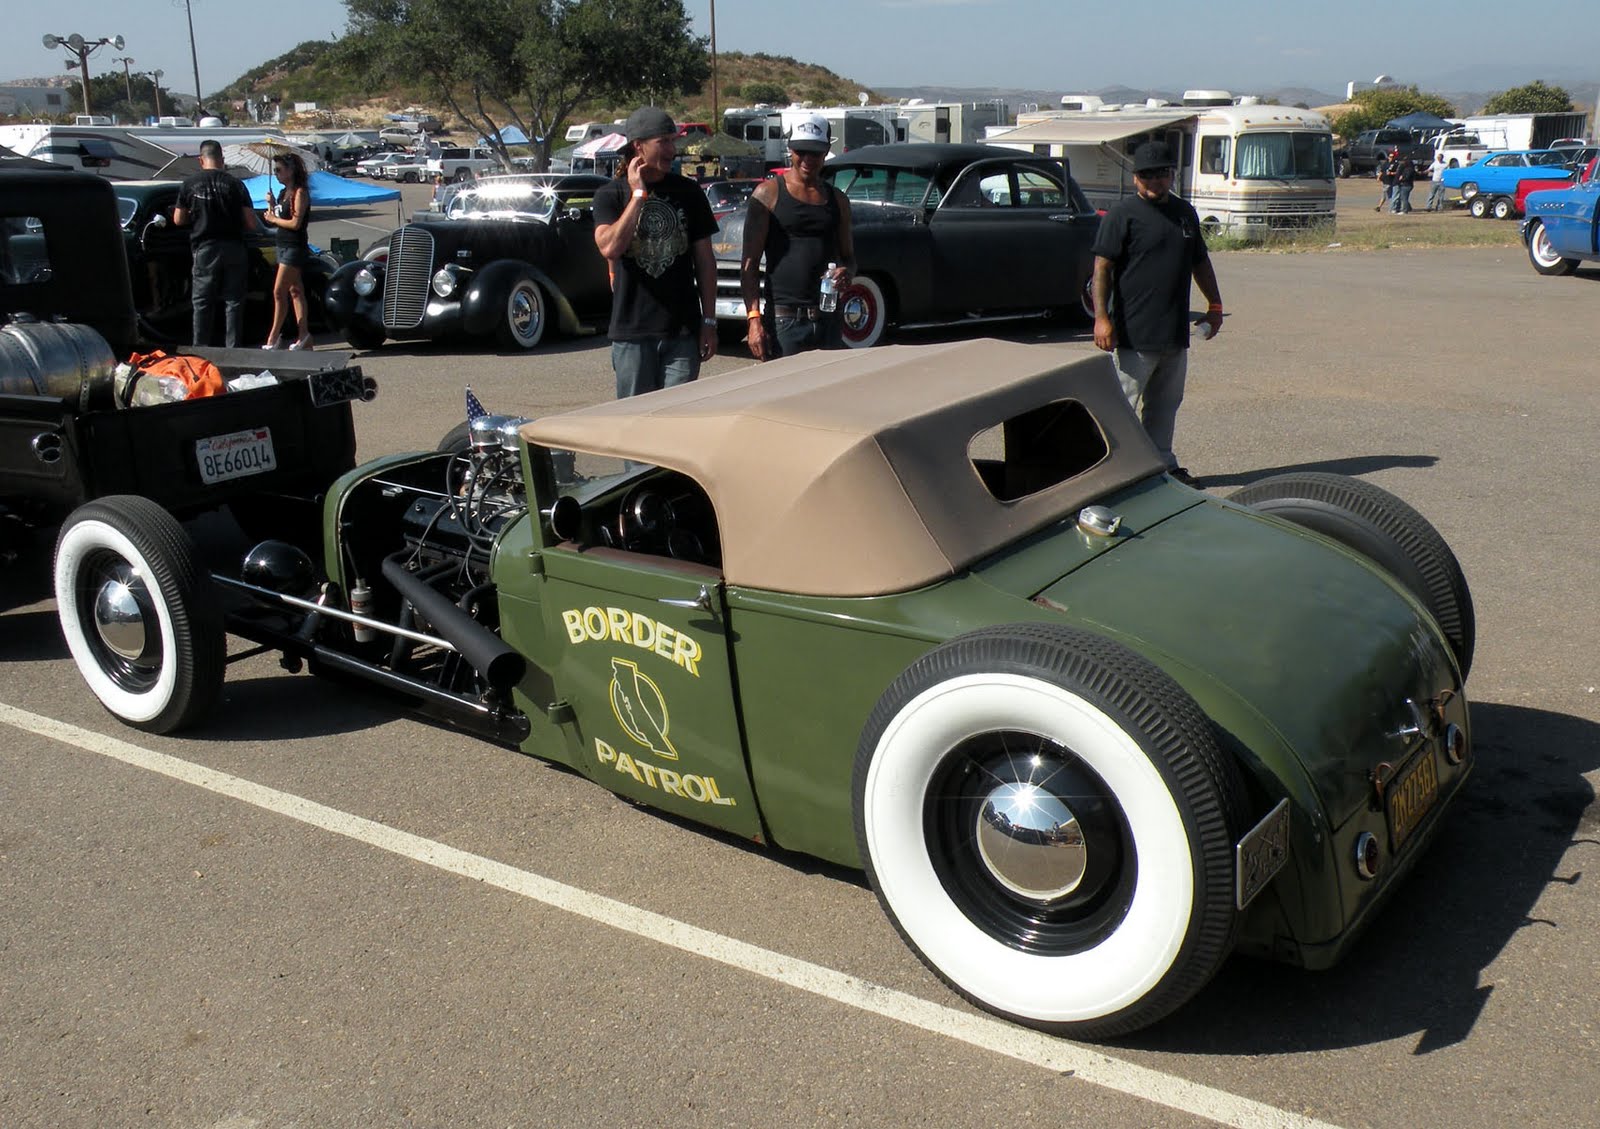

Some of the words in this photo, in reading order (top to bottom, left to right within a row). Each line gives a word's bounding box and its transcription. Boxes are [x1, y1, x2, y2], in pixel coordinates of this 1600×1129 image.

[204, 444, 270, 476] 8E66014
[562, 606, 702, 677] BORDER
[595, 737, 736, 806] PATROL
